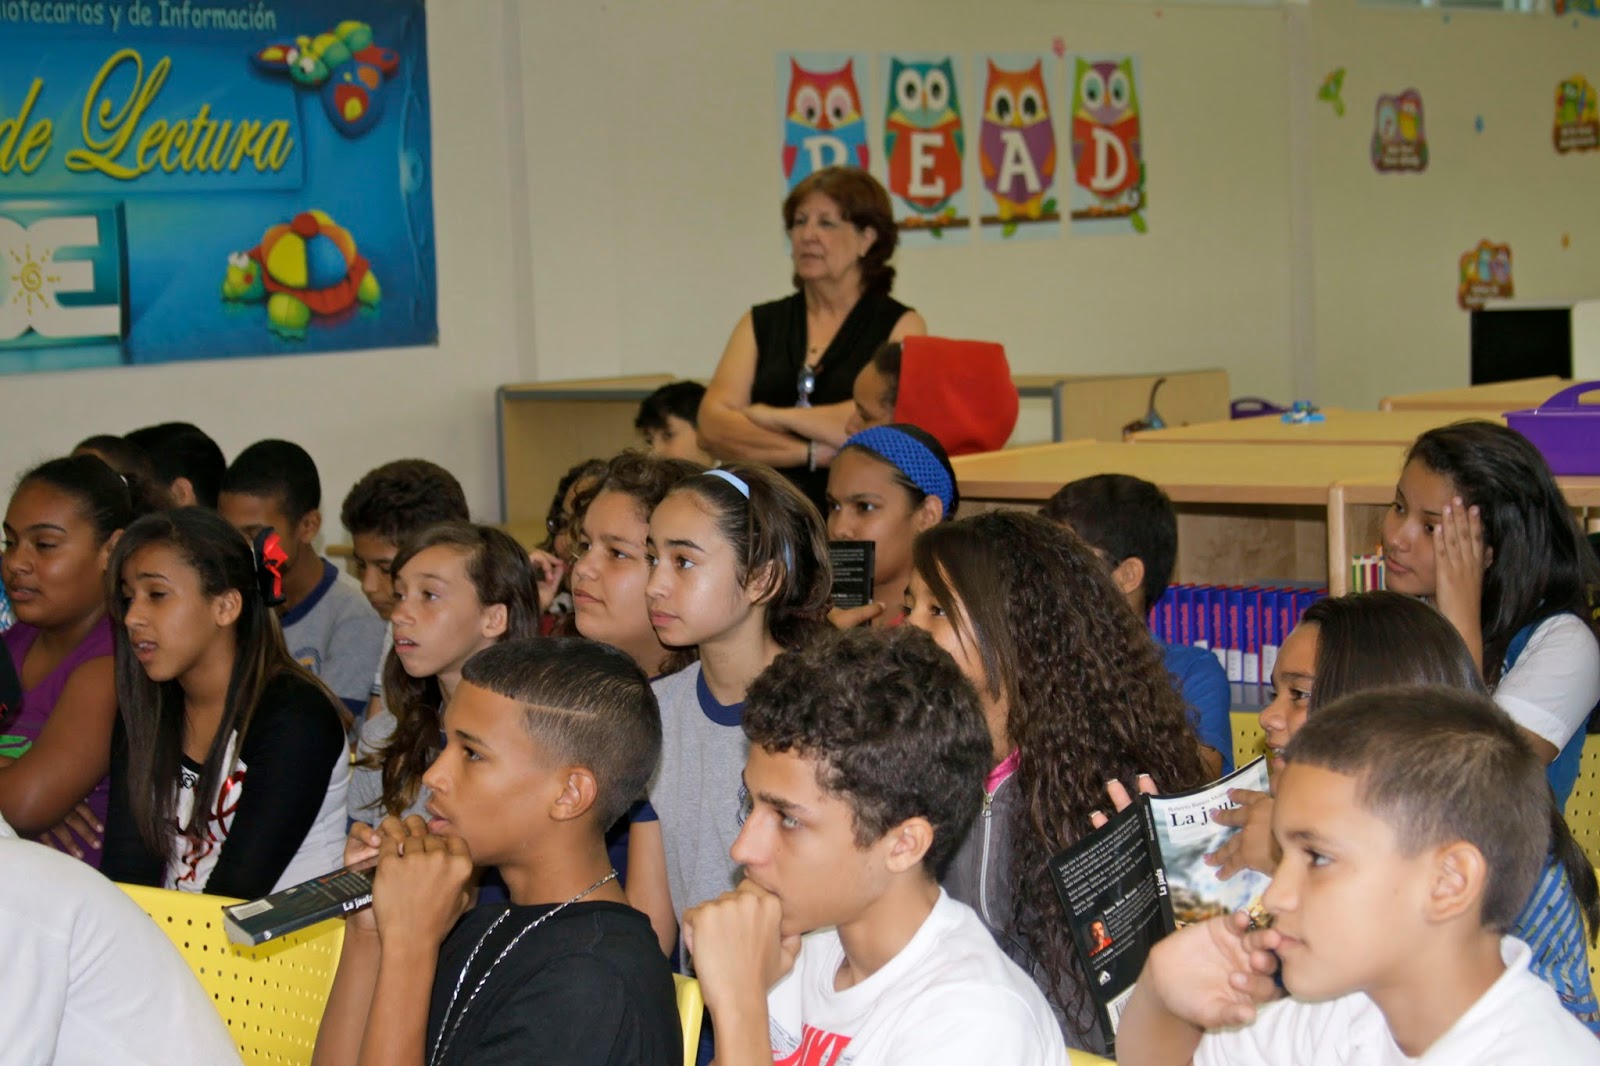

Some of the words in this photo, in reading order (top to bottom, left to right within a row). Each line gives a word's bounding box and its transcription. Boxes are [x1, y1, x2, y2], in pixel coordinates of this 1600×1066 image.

[110, 4, 121, 32] y
[128, 0, 150, 26] de
[159, 2, 277, 30] Información
[65, 48, 293, 179] Lectura
[1170, 810, 1196, 827] La
[342, 901, 354, 911] La
